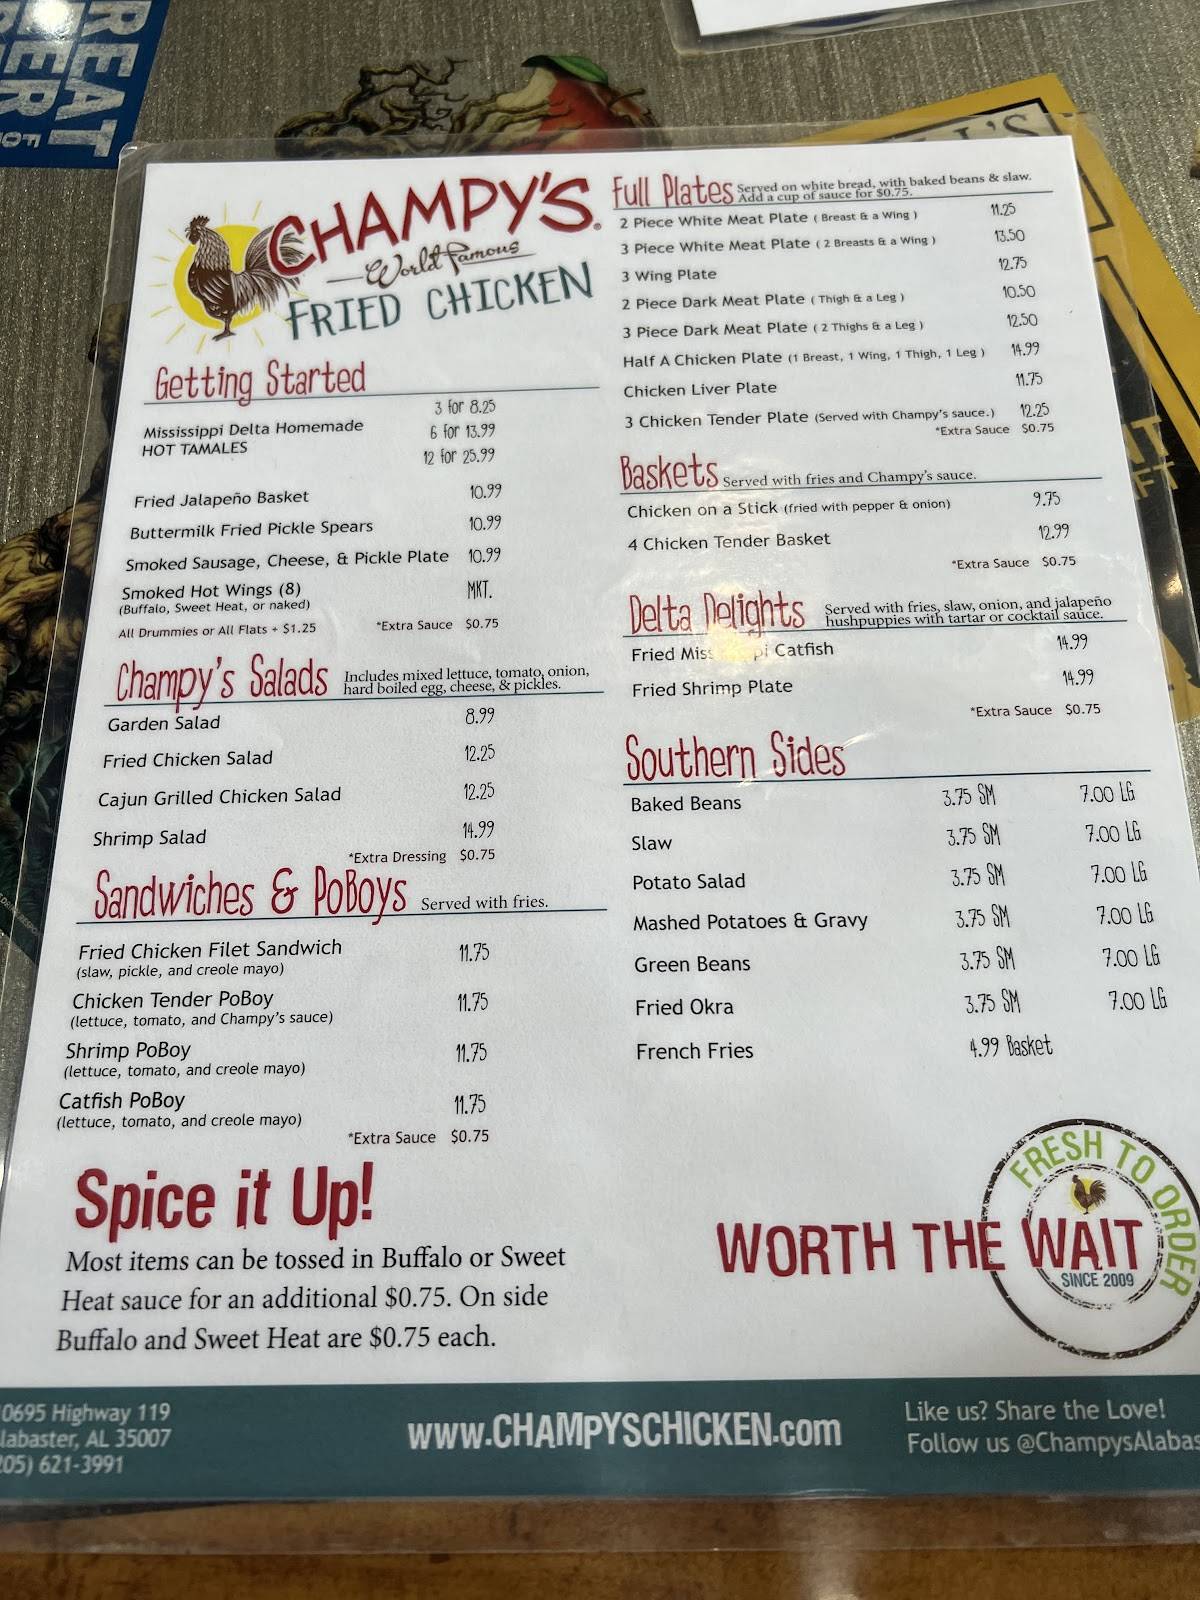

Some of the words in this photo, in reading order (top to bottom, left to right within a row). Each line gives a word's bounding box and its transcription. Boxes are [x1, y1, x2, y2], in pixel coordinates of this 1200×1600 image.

[611, 176, 649, 208] Full
[662, 174, 734, 206] Plates
[267, 171, 594, 277] CHAMPY'S
[365, 244, 443, 289] World
[441, 240, 520, 276] Famous
[999, 256, 1027, 271] 12.75
[622, 271, 630, 282] 3
[635, 270, 672, 283] Wing
[678, 269, 717, 280] Plate
[285, 292, 401, 340] FRIED
[426, 261, 592, 320] CHICKEN
[155, 367, 254, 406] Getting
[266, 359, 366, 395] Started
[1016, 372, 1043, 386] 11.75
[624, 385, 685, 398] Chicken
[692, 384, 731, 395] Liver
[736, 382, 777, 394] Plate
[625, 416, 633, 428] 3
[639, 415, 701, 428] Chicken
[707, 412, 762, 426] Tender
[768, 411, 808, 423] Plate
[815, 412, 858, 423] (Served
[862, 411, 888, 420] with
[892, 409, 948, 421] Champy's
[952, 408, 994, 418] sauce.)
[1020, 402, 1049, 418] 12.25
[144, 424, 223, 440] Mississippi
[229, 423, 270, 436] Delta
[276, 419, 364, 434] Homemade
[430, 425, 437, 439] 6
[443, 424, 460, 439] for
[466, 423, 495, 438] 13.99
[142, 443, 176, 457] HOT
[180, 441, 247, 455] TAMALES
[620, 456, 720, 490] Baskets
[135, 494, 175, 508] Fried
[179, 492, 251, 508] Jalapeño
[257, 490, 309, 504] Basket
[470, 484, 502, 499] 10.99
[1033, 491, 1060, 507] 9.75
[628, 504, 691, 518] Chicken
[698, 506, 717, 516] on
[723, 504, 732, 515] a
[738, 501, 778, 514] Stick
[784, 503, 817, 515] (fried
[821, 502, 848, 512] with
[853, 502, 895, 513] pepper
[899, 500, 908, 509] &
[913, 499, 950, 510] onion)
[628, 538, 637, 551] 4
[643, 537, 708, 551] Chicken
[713, 534, 771, 548] Tender
[777, 532, 831, 546] Basket
[1039, 523, 1069, 540] 12.99
[122, 585, 185, 600] Smoked
[191, 585, 219, 598] Hot
[225, 584, 272, 599] Wings
[279, 582, 301, 598] (8)
[468, 580, 492, 600] MKT.
[418, 620, 453, 630] Sauce
[466, 618, 498, 630] $0.75
[628, 594, 692, 634] Delta
[703, 590, 806, 638] Delights
[115, 656, 236, 713] Champy's
[249, 653, 328, 698] Salads
[1063, 669, 1094, 686] 14.99
[633, 682, 676, 697] Fried
[682, 681, 742, 698] Shrimp
[749, 680, 793, 694] Plate
[108, 717, 168, 732] Garden
[174, 715, 220, 730] Salad
[466, 707, 494, 724] 8.99
[103, 753, 147, 768] Fried
[152, 752, 220, 767] Chicken
[226, 750, 273, 765] Salad
[465, 744, 495, 762] 12.25
[625, 735, 756, 781] Southern
[771, 730, 846, 777] Sides
[942, 788, 972, 806] 3.75
[978, 783, 996, 805] SM
[1080, 785, 1114, 803] 7.00
[1119, 781, 1135, 802] LG
[632, 796, 683, 812] Baked
[691, 796, 741, 811] Beans
[632, 836, 672, 851] Slaw
[94, 869, 253, 920] Sandwiches
[271, 867, 298, 915] &
[314, 864, 407, 925] PoBoys
[634, 914, 700, 931] Mashed
[708, 914, 787, 929] Potatoes
[794, 913, 808, 928] &
[814, 912, 868, 931] Gravy
[955, 909, 985, 928] 3.75
[991, 904, 1010, 928] SM
[1096, 906, 1132, 925] 7.00
[1137, 902, 1154, 924] LG
[79, 944, 125, 960] Fried
[131, 943, 201, 959] Chicken
[209, 941, 250, 958] Filet
[256, 939, 341, 956] Sandwich
[459, 943, 489, 962] 11.75
[76, 966, 112, 981] (slaw,
[118, 965, 162, 980] pickle,
[168, 964, 192, 976] and
[196, 963, 238, 975] creole
[243, 962, 284, 977] mayo)
[637, 1042, 700, 1060] French
[708, 1042, 753, 1059] Fries
[970, 1037, 999, 1058] 4.99
[1006, 1034, 1053, 1056] Basket
[59, 1092, 122, 1110] Catfish
[130, 1092, 185, 1112] PoBoy
[454, 1094, 486, 1115] 11.75
[74, 1168, 216, 1244] Spice
[235, 1169, 271, 1229] it
[292, 1161, 374, 1241] Up!
[1010, 1130, 1102, 1195] FRESH
[1117, 1140, 1156, 1184] TO
[1152, 1184, 1198, 1296] ORDER
[716, 1221, 896, 1278] WORTH
[912, 1220, 1006, 1274] THE
[1021, 1217, 1142, 1271] WAIT
[65, 1251, 123, 1272] Most
[128, 1251, 189, 1271] items
[196, 1255, 234, 1270] can
[242, 1248, 268, 1270] be
[275, 1246, 344, 1270] tossed
[352, 1248, 374, 1269] in
[381, 1245, 462, 1268] Buffalo
[470, 1252, 494, 1268] or
[501, 1246, 566, 1267] Sweet
[1061, 1272, 1099, 1287] SINCE
[1103, 1273, 1134, 1287] 2009
[52, 1403, 131, 1426] Highway
[138, 1403, 170, 1421] 119
[905, 1401, 949, 1421] Like
[957, 1400, 988, 1421] us?
[995, 1400, 1056, 1421] Share
[1063, 1399, 1099, 1420] the
[1107, 1398, 1166, 1419] Love!
[85, 1429, 110, 1448] AL
[115, 1428, 172, 1448] 35007
[908, 1432, 979, 1453] Follow
[986, 1437, 1010, 1453] us
[39, 1454, 123, 1474] 621-3991
